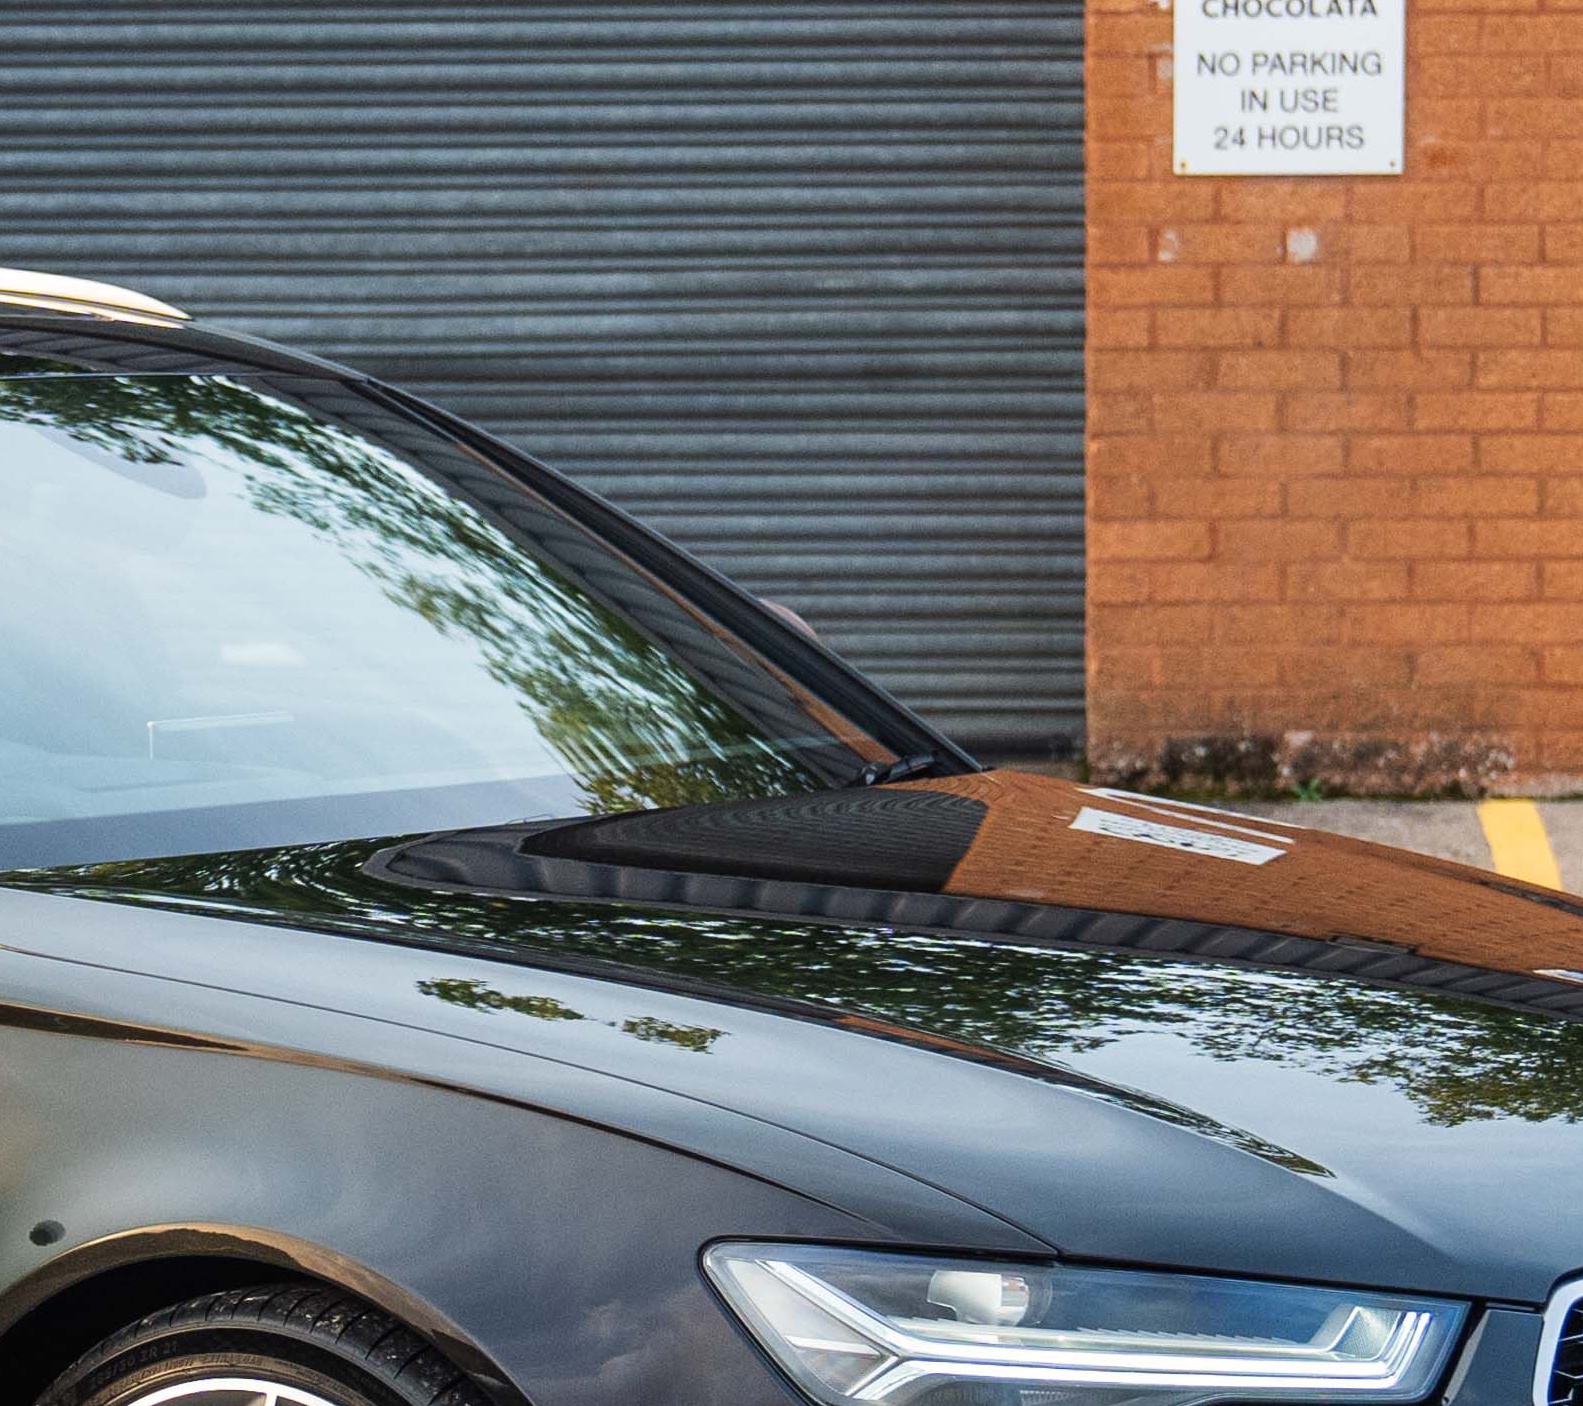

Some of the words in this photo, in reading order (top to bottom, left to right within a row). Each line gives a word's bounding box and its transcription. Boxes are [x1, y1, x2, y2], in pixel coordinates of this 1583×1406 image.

[1197, 52, 1241, 77] NO
[1251, 51, 1382, 77] PARKING
[1240, 89, 1268, 113] IN
[1279, 88, 1339, 113] USE
[1214, 125, 1246, 150] 24
[1257, 125, 1365, 150] HOURS
